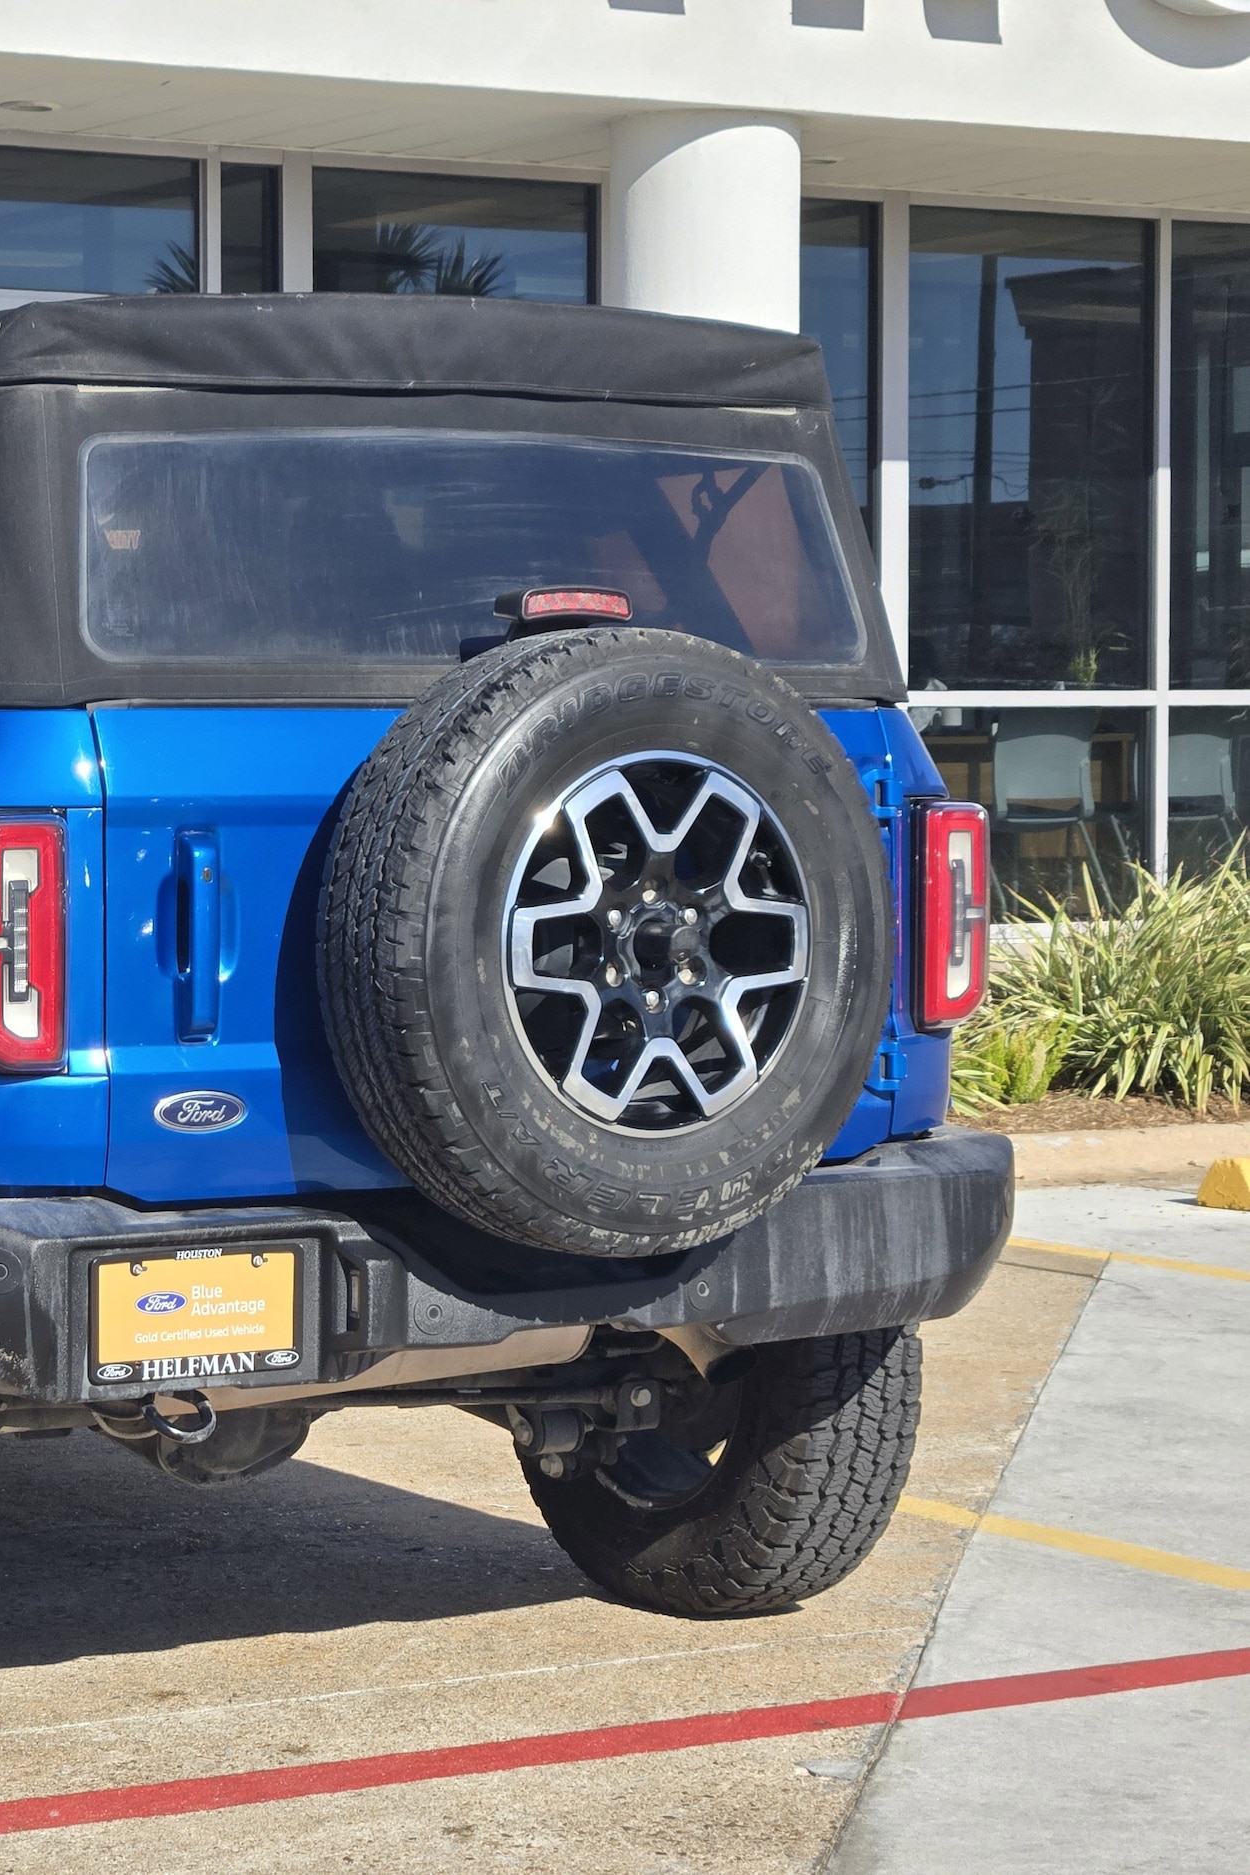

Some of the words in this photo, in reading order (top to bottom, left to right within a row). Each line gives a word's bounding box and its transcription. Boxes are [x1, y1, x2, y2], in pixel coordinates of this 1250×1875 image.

[496, 672, 833, 798] BRIDGESTONE
[177, 1100, 227, 1124] Ford
[176, 1248, 223, 1260] HOUSTON
[191, 1285, 223, 1300] Blue
[191, 1299, 266, 1317] Advantage
[135, 1332, 158, 1344] Gold
[160, 1328, 202, 1341] Certified
[204, 1326, 229, 1338] Used
[231, 1323, 265, 1336] Vehicle
[141, 1351, 257, 1381] HELFMAN
